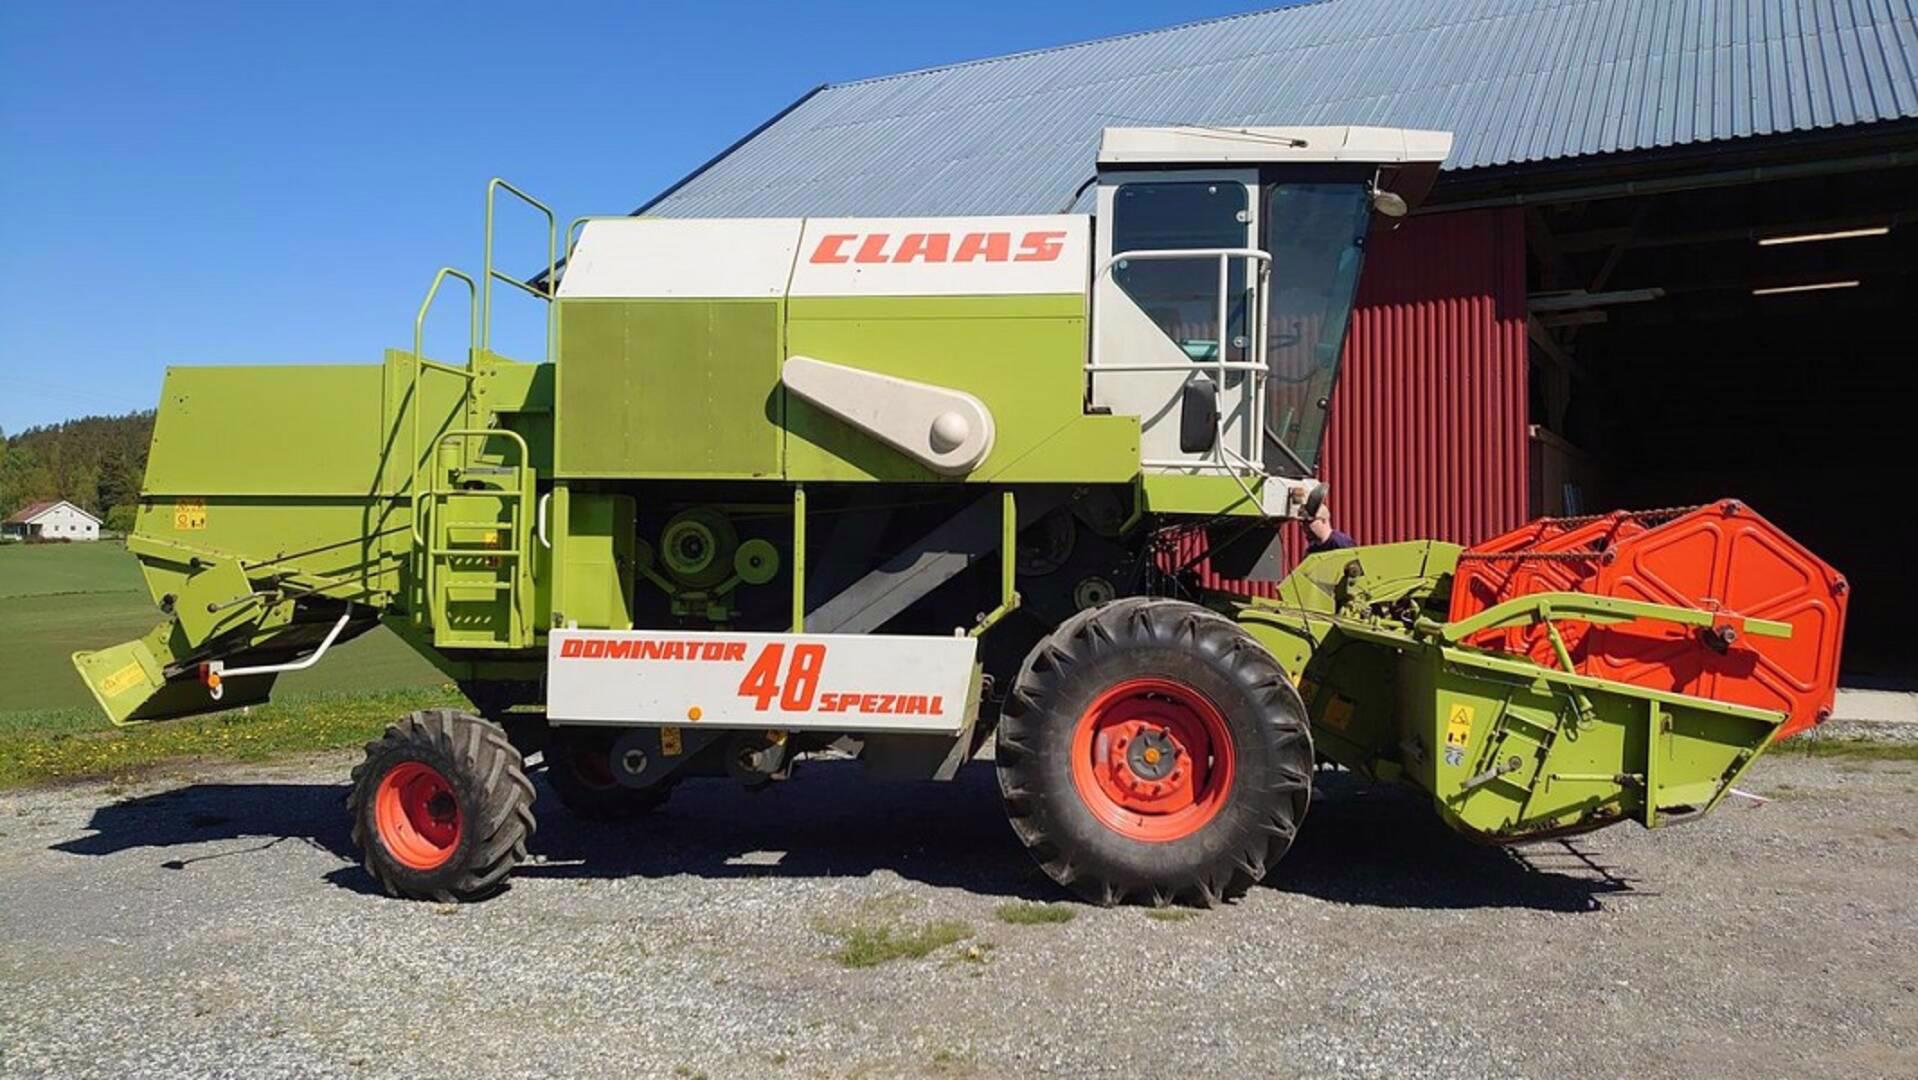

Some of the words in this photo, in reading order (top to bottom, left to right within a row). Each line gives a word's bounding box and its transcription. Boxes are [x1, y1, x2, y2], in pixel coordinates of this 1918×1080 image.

[809, 231, 1066, 263] CLAAS
[560, 638, 747, 663] DOMINATOR
[737, 642, 827, 712] 48
[819, 691, 942, 716] SPEZIAL
